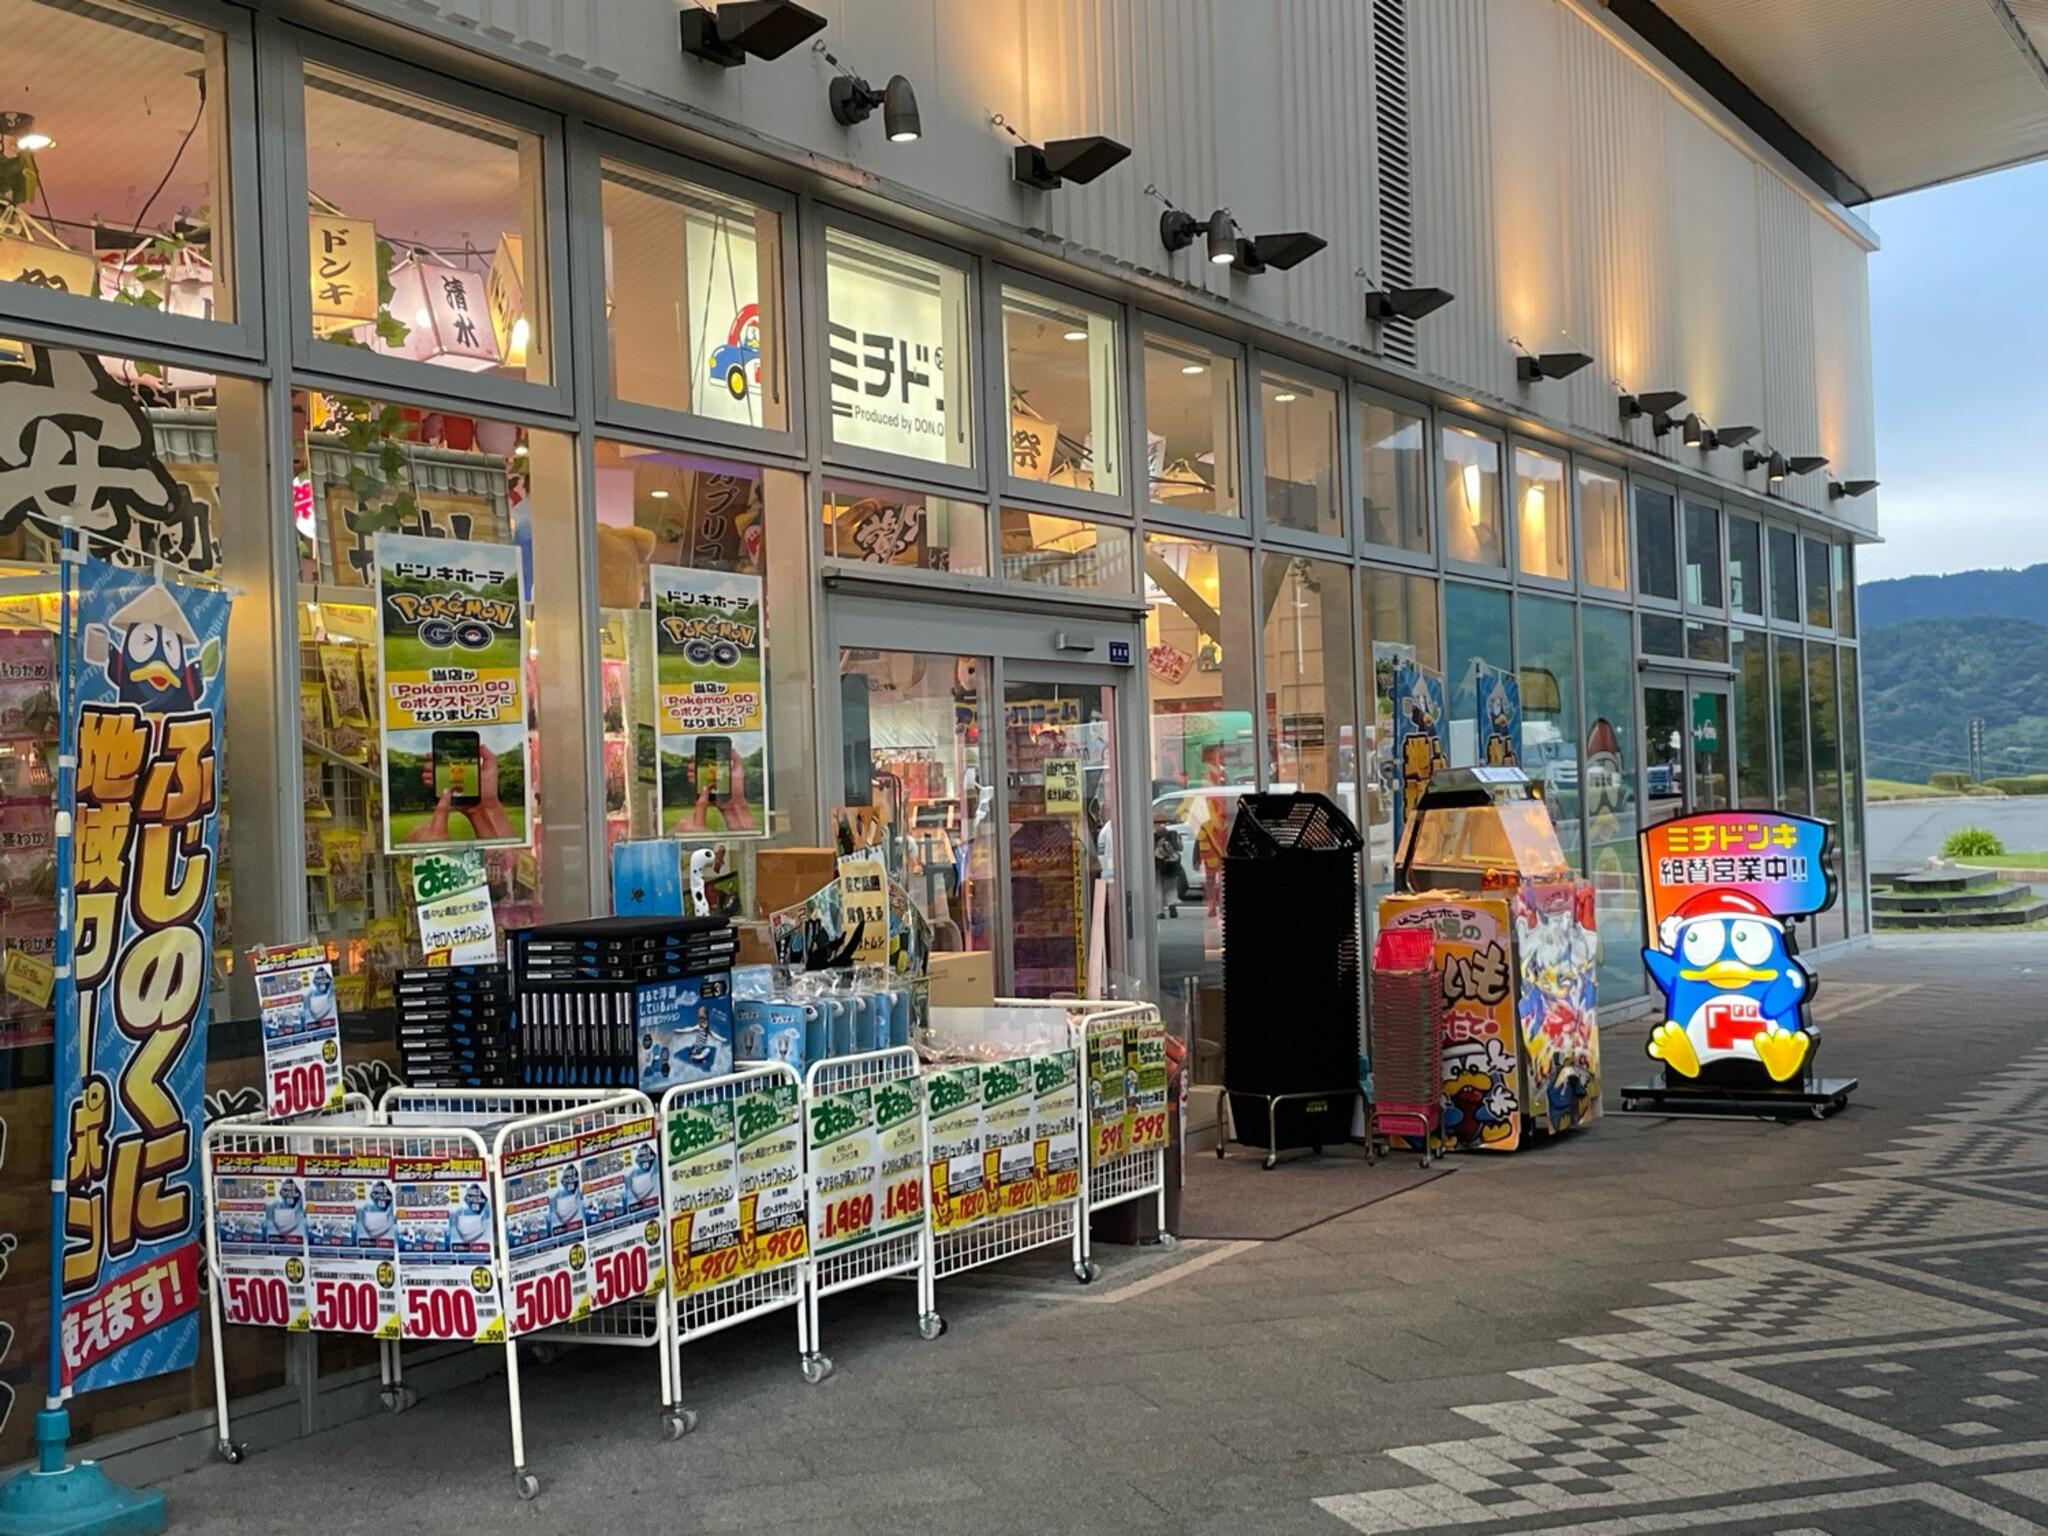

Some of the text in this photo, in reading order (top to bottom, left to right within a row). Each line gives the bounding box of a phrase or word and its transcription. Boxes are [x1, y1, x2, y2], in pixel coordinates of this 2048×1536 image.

[319, 228, 353, 306] ドンキ
[440, 275, 481, 348] 清水
[854, 404, 899, 428] Produced
[901, 415, 913, 434] by
[418, 619, 495, 651] GO
[684, 640, 741, 668] GO
[431, 669, 474, 682] 当店が
[694, 683, 726, 693] 当店が
[400, 695, 510, 709] のポケストップに
[671, 705, 753, 718] のポケストップに
[1667, 822, 1798, 852] ミチドンキ
[1660, 857, 1808, 884] 絶賛営業中!!
[108, 716, 216, 1250] ふじのくに
[767, 1228, 805, 1260] 980
[702, 1248, 739, 1281] 980
